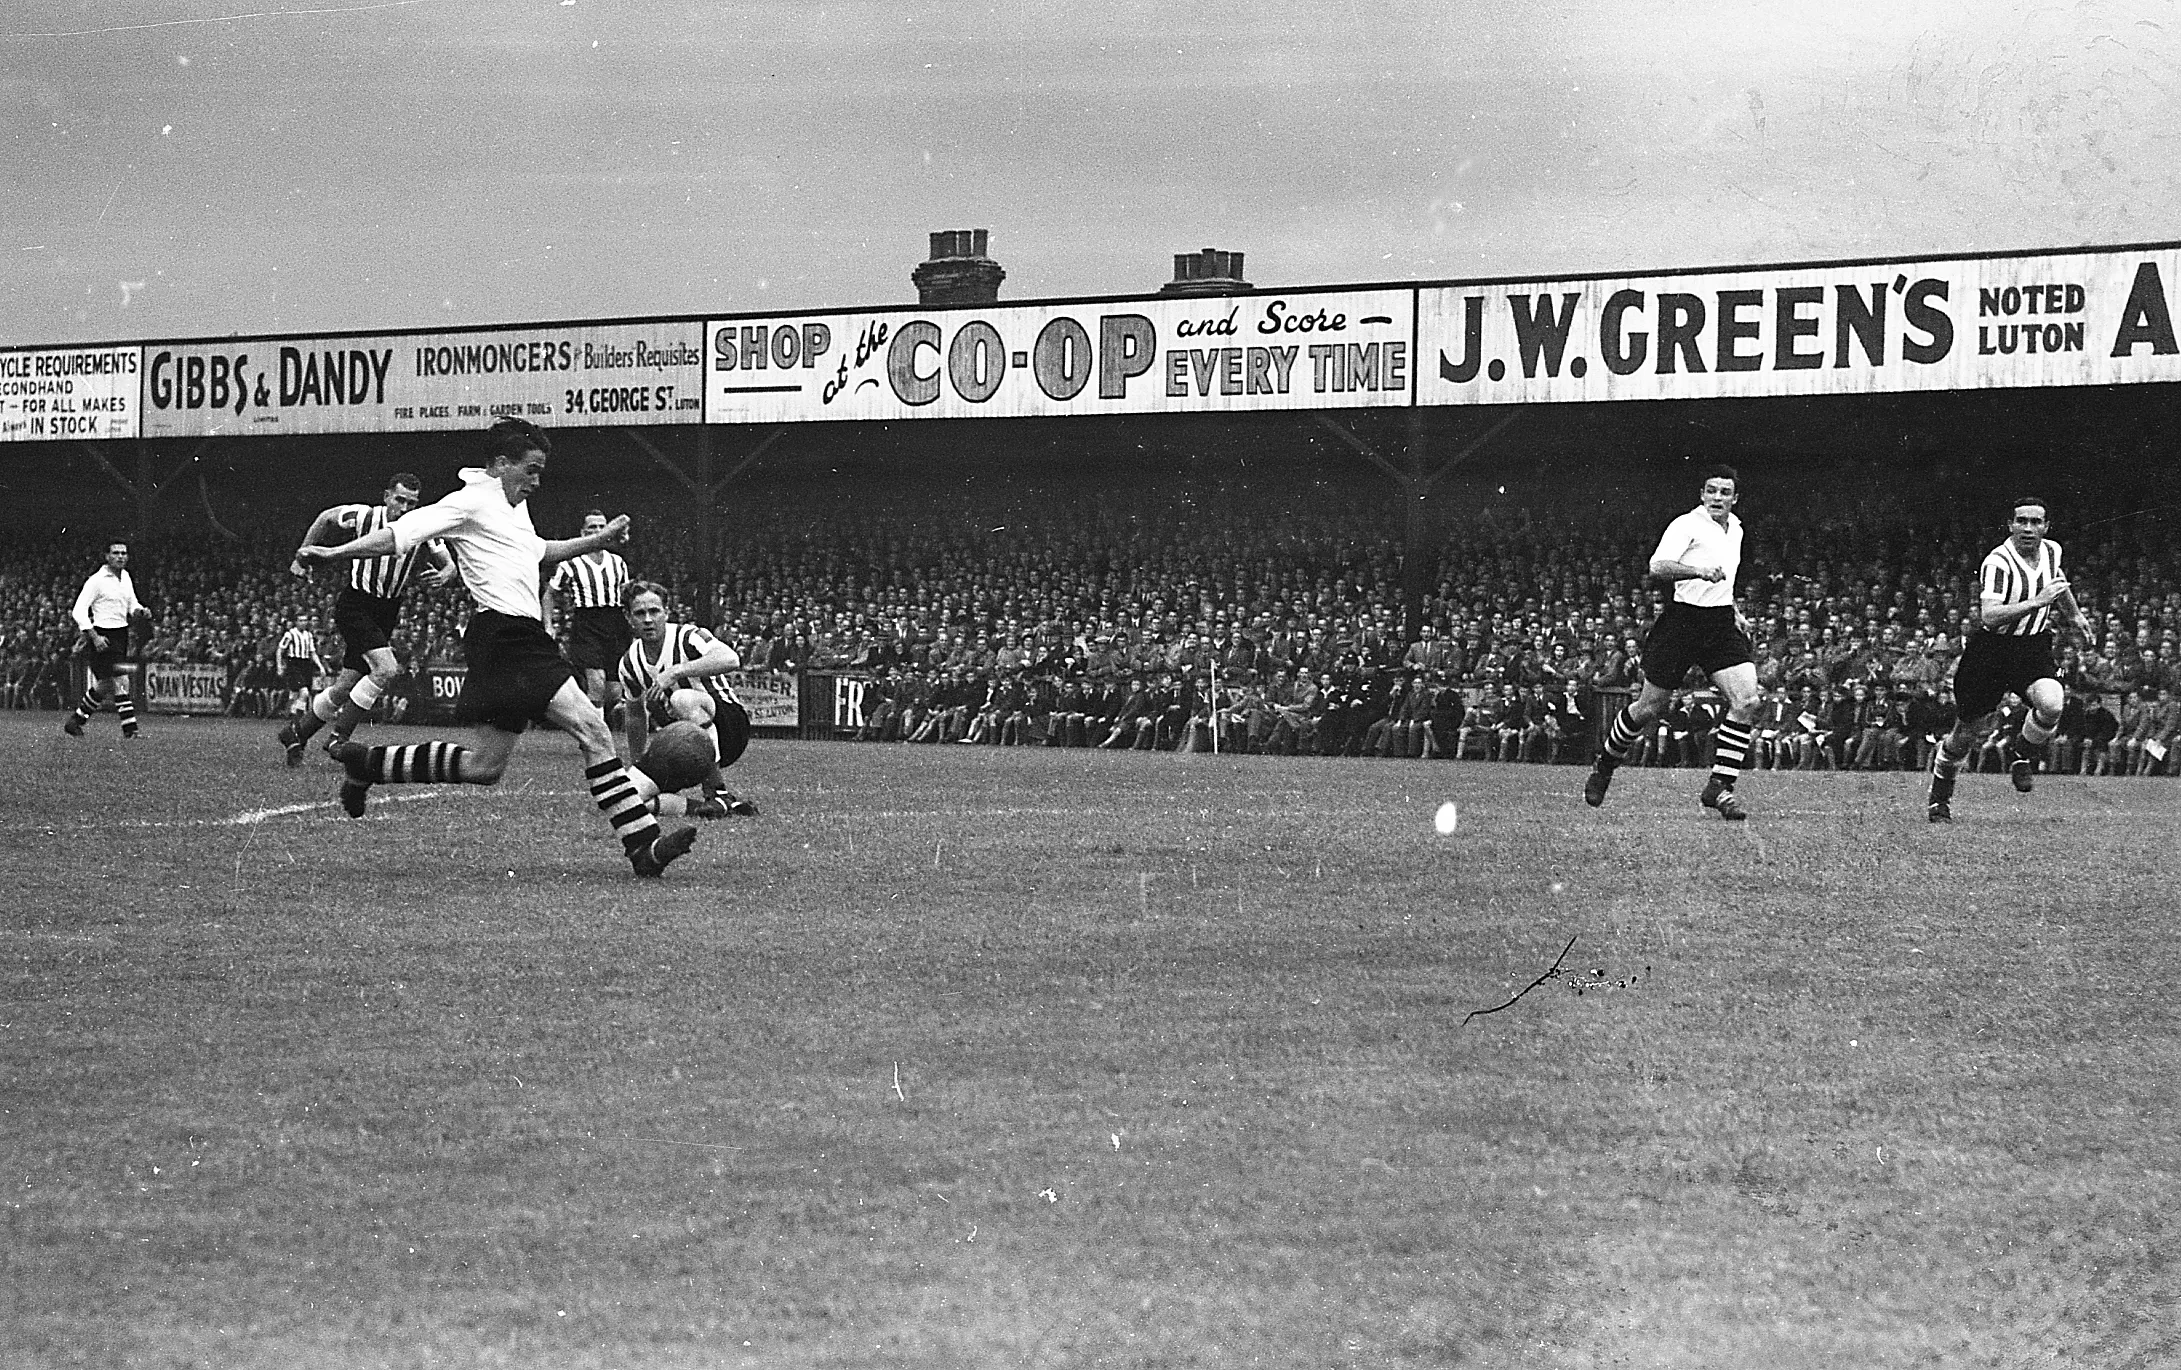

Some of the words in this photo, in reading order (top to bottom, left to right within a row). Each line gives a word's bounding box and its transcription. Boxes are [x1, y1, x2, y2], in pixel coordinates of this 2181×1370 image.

[1978, 284, 2085, 317] NOTED
[1176, 305, 1239, 338] and
[1257, 300, 1347, 334] Score
[1601, 274, 1952, 376] GREEN'S
[714, 323, 831, 372] SHOP
[1978, 322, 2085, 355] LUTON
[35, 352, 137, 377] REQUIREMENTS
[415, 340, 572, 376] IRONMONGERS
[584, 342, 634, 370] Builders
[636, 340, 699, 371] Requisites
[822, 353, 848, 405] at
[853, 319, 888, 370] the
[887, 313, 1157, 407] CO-OP
[1166, 344, 1300, 397] EVERY
[1308, 341, 1406, 393] TIME
[0, 380, 74, 396] CONDHAND
[150, 351, 248, 416] GIBBS
[254, 372, 270, 407] &
[279, 346, 393, 407] DANDY
[22, 399, 46, 413] FOR
[51, 398, 76, 413] ALL
[82, 397, 126, 412] MAKES
[419, 405, 449, 418] PLACES
[457, 405, 481, 416] FARM
[489, 403, 523, 416] GARDEN
[589, 386, 650, 413] GEORGE
[30, 416, 45, 434] IN
[50, 415, 98, 434] STOCK
